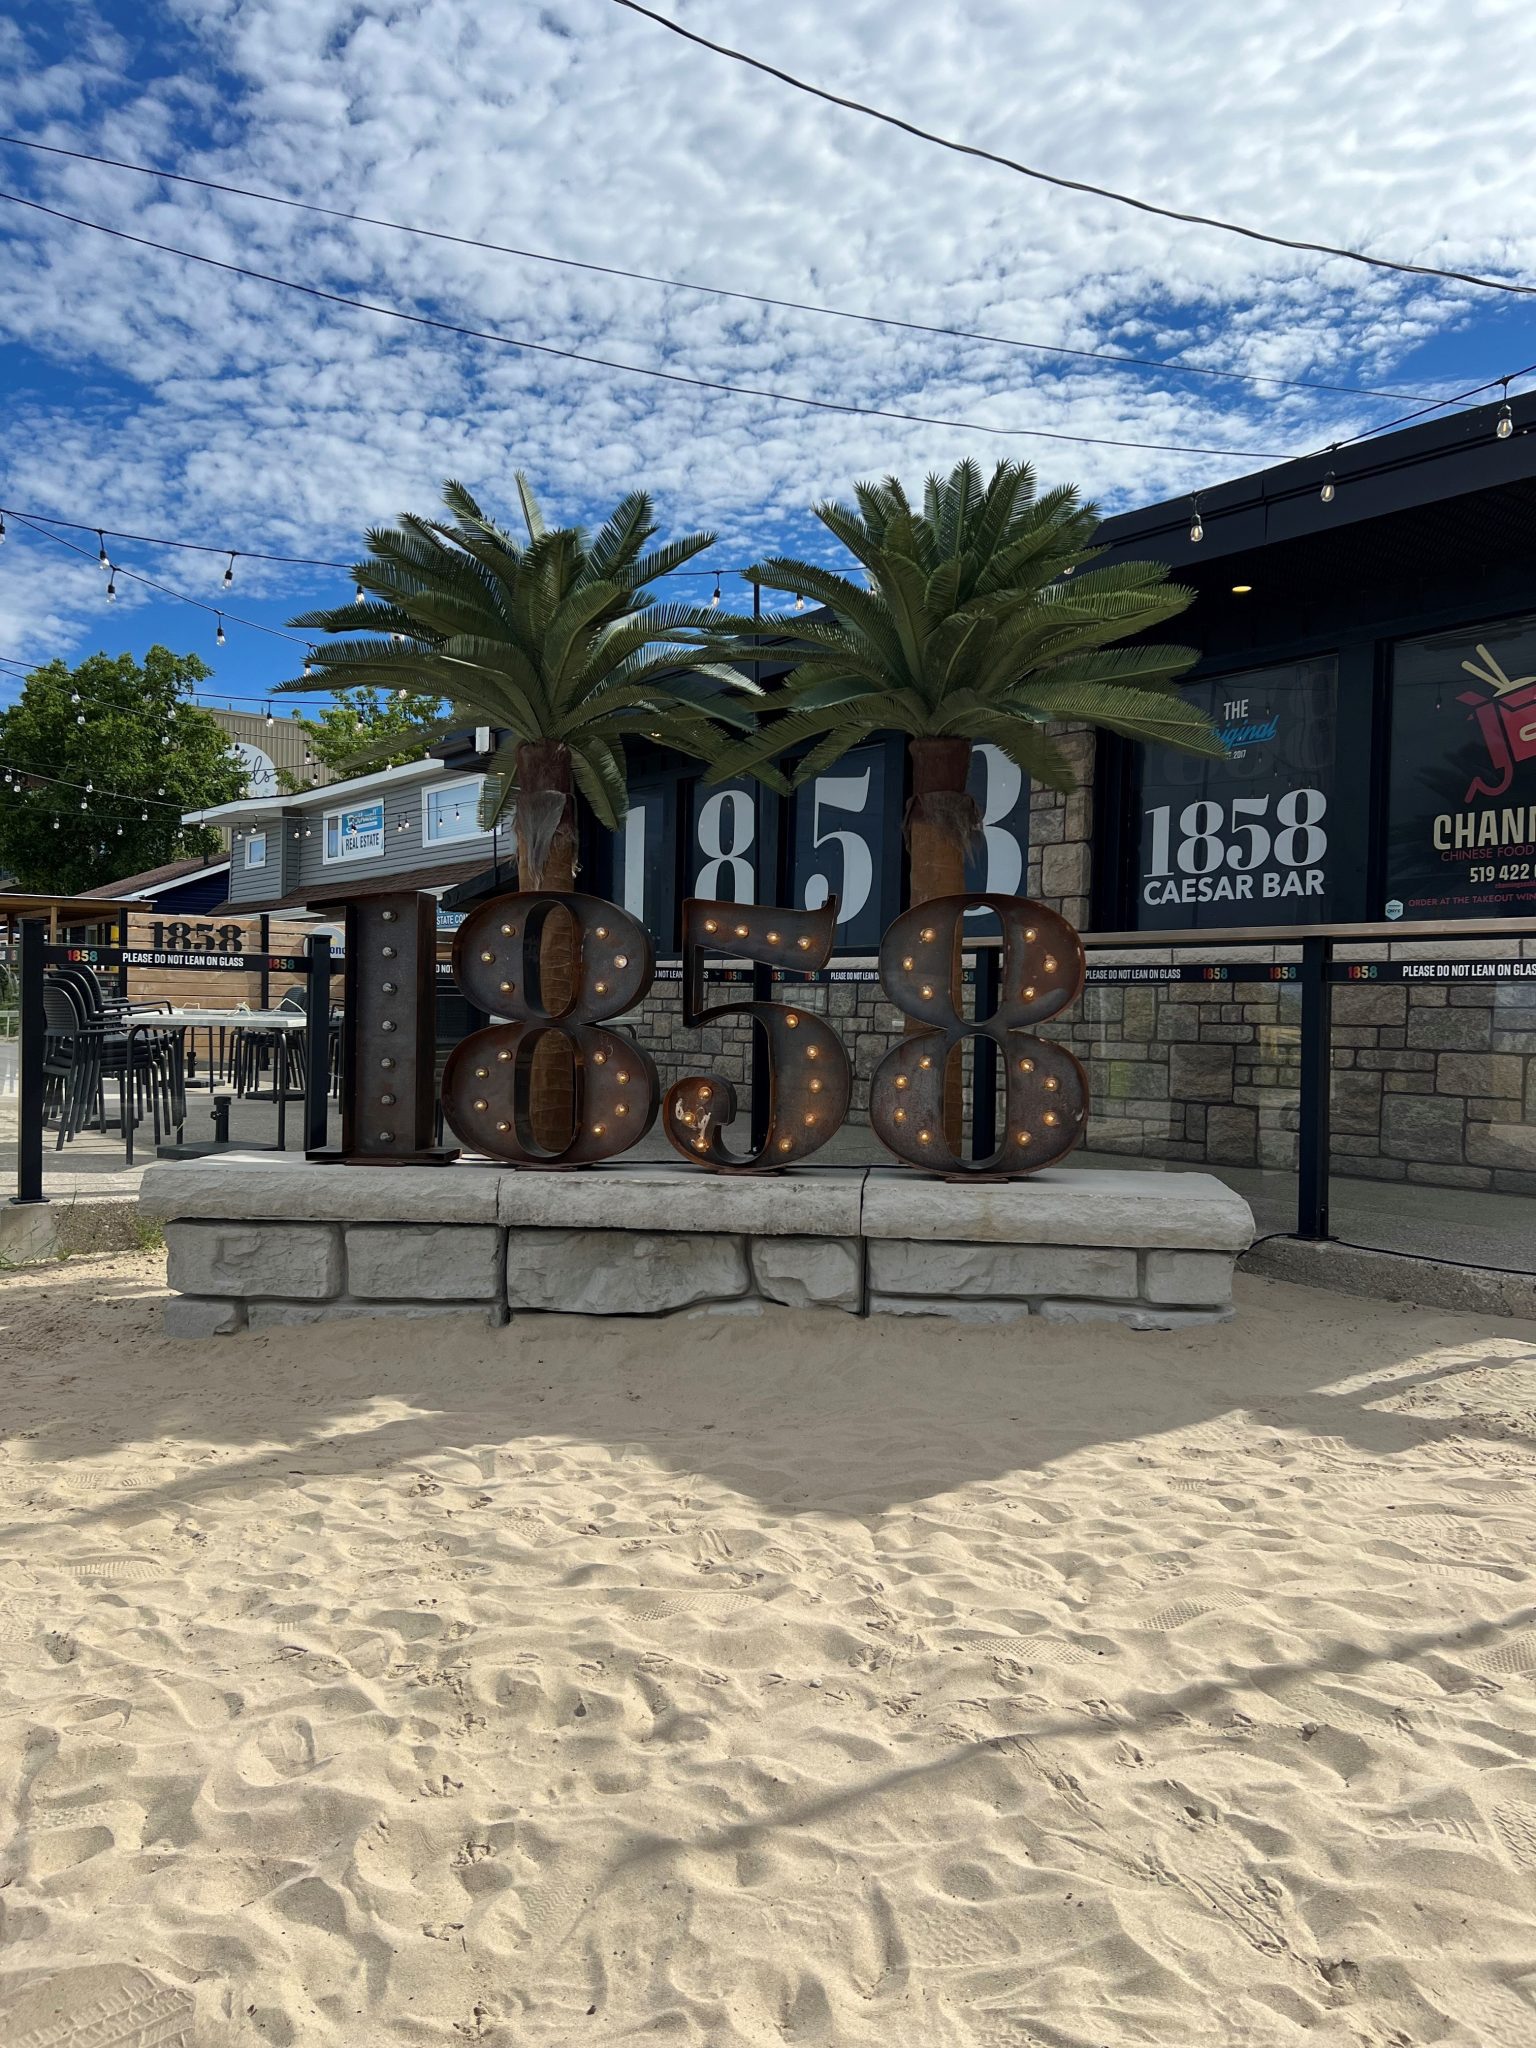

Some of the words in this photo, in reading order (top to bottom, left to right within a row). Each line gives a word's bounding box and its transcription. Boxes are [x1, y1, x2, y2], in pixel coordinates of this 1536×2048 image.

[1223, 699, 1249, 721] THE
[1143, 788, 1328, 878] 1858
[345, 836, 359, 851] REAL
[360, 832, 380, 849] ESTATE
[1440, 847, 1493, 862] CHINESE
[1497, 844, 1535, 857] FOOD
[1469, 865, 1496, 883] 519
[1498, 863, 1530, 881] 422
[1143, 874, 1254, 905] CAESAR
[1262, 869, 1325, 898] BAR
[1408, 898, 1438, 907] ORDER
[1439, 898, 1449, 906] AT
[1452, 896, 1470, 905] THE
[1472, 893, 1514, 904] TAKEOUT
[1515, 892, 1536, 901] WIN
[436, 913, 454, 925] STATE
[148, 921, 243, 952] 1858
[67, 949, 98, 962] 1858
[122, 952, 153, 963] PLEASE
[154, 954, 166, 964] DO
[167, 955, 184, 964] NOT
[184, 955, 205, 965] LEAN
[206, 956, 218, 966] ON
[219, 956, 244, 967] GLASS
[268, 958, 295, 970] 1858
[1402, 965, 1436, 977] PLEASE
[1436, 964, 1450, 977] DO
[1451, 964, 1471, 977] NOT
[1471, 964, 1496, 976] LEAN
[1497, 964, 1512, 976] ON
[1513, 963, 1536, 976] GLAS
[658, 970, 669, 978] NOT
[830, 971, 847, 980] PLEASE
[846, 971, 854, 980] DO
[853, 971, 863, 980] NOT
[862, 971, 875, 980] LEAN
[1085, 969, 1108, 980] PLEASE
[1108, 969, 1118, 979] DO
[1118, 969, 1131, 979] NOT
[1131, 969, 1148, 979] LEAN
[1148, 969, 1159, 979] ON
[1159, 968, 1181, 979] GLASS
[1203, 967, 1228, 979] 1858
[1270, 966, 1297, 979] 1858
[1348, 965, 1378, 978] 1858
[306, 891, 1089, 1182] 1858
